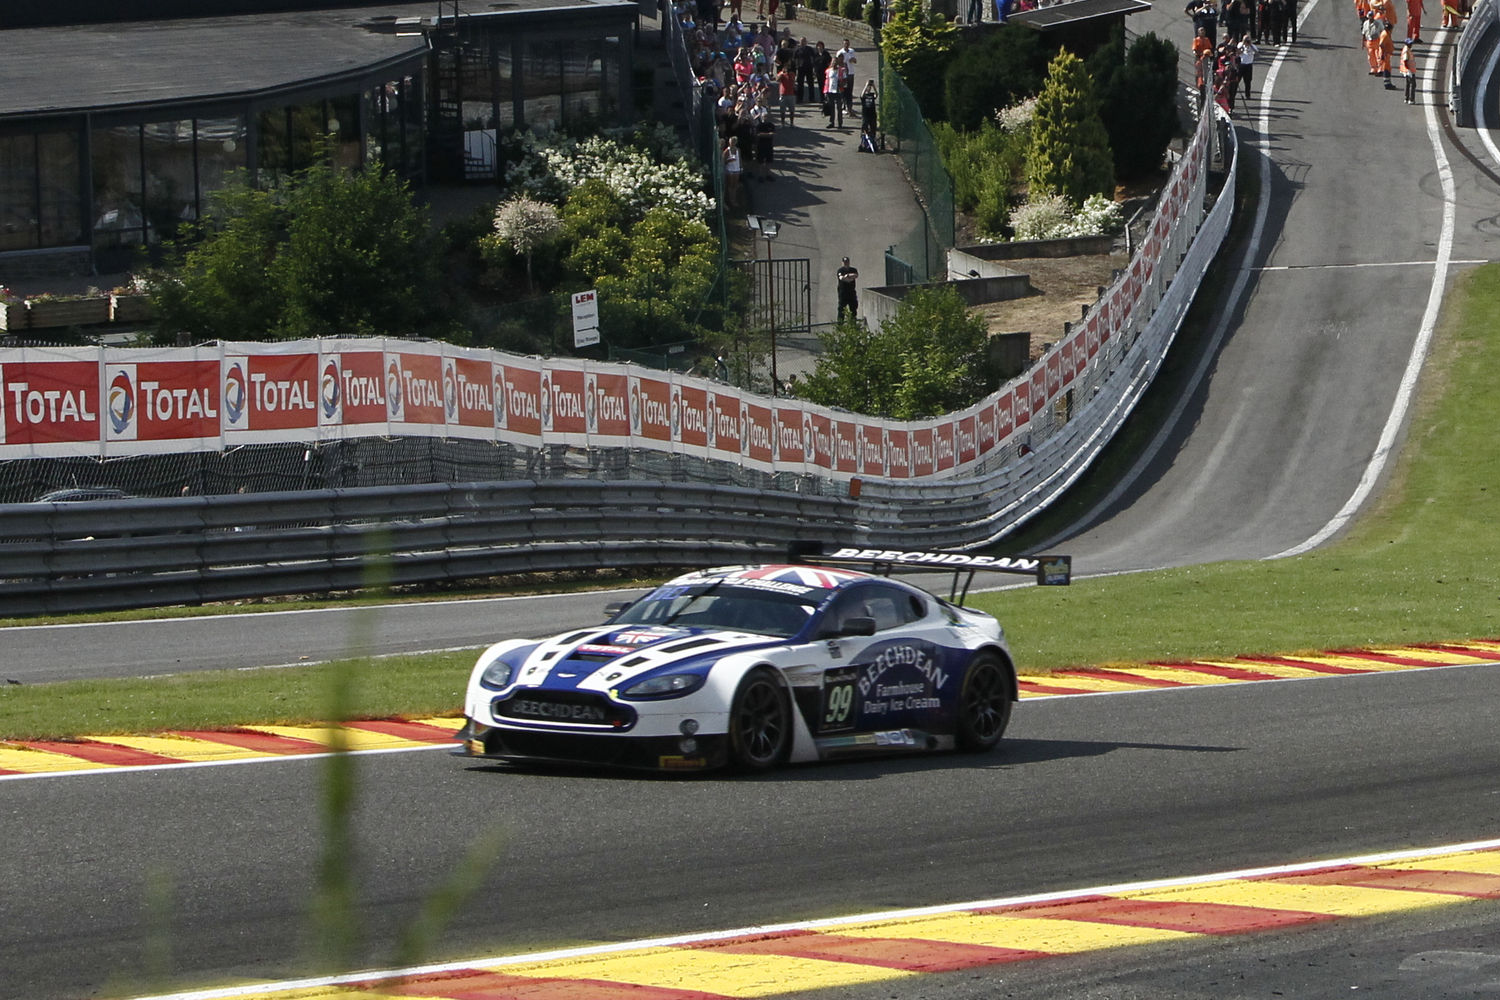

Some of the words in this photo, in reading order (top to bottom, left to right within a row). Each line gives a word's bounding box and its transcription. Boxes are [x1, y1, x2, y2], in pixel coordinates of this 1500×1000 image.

[576, 293, 594, 304] LEM
[8, 382, 96, 424] TOTAL
[141, 381, 217, 421] TOTAL
[250, 373, 315, 411] TOTAL
[342, 369, 385, 406] TOTAL
[403, 371, 443, 408] TOTAL
[458, 374, 493, 412] TOTAL
[506, 378, 540, 420] TOTAL
[553, 385, 585, 418] TOTAL
[597, 389, 627, 421] TOTAL
[641, 392, 670, 427] TOTAL
[682, 399, 707, 433] TOTAL
[716, 406, 740, 440] TOTAL
[749, 417, 771, 449] TOTAL
[779, 421, 803, 450] TOTAL
[813, 426, 831, 456] TOTAL
[837, 434, 856, 460] TOTAL
[864, 438, 883, 464] TOTAL
[889, 441, 908, 467] TOTAL
[914, 441, 932, 464] TOTAL
[831, 548, 1040, 570] BEECHDEAN
[858, 644, 950, 696] BEECHDEAN
[825, 684, 853, 722] 99
[877, 680, 924, 697] Farmhouse
[511, 699, 606, 722] BEECHDEAN
[864, 700, 887, 716] Dairy
[890, 699, 904, 711] Ice
[905, 696, 941, 711] Cream
